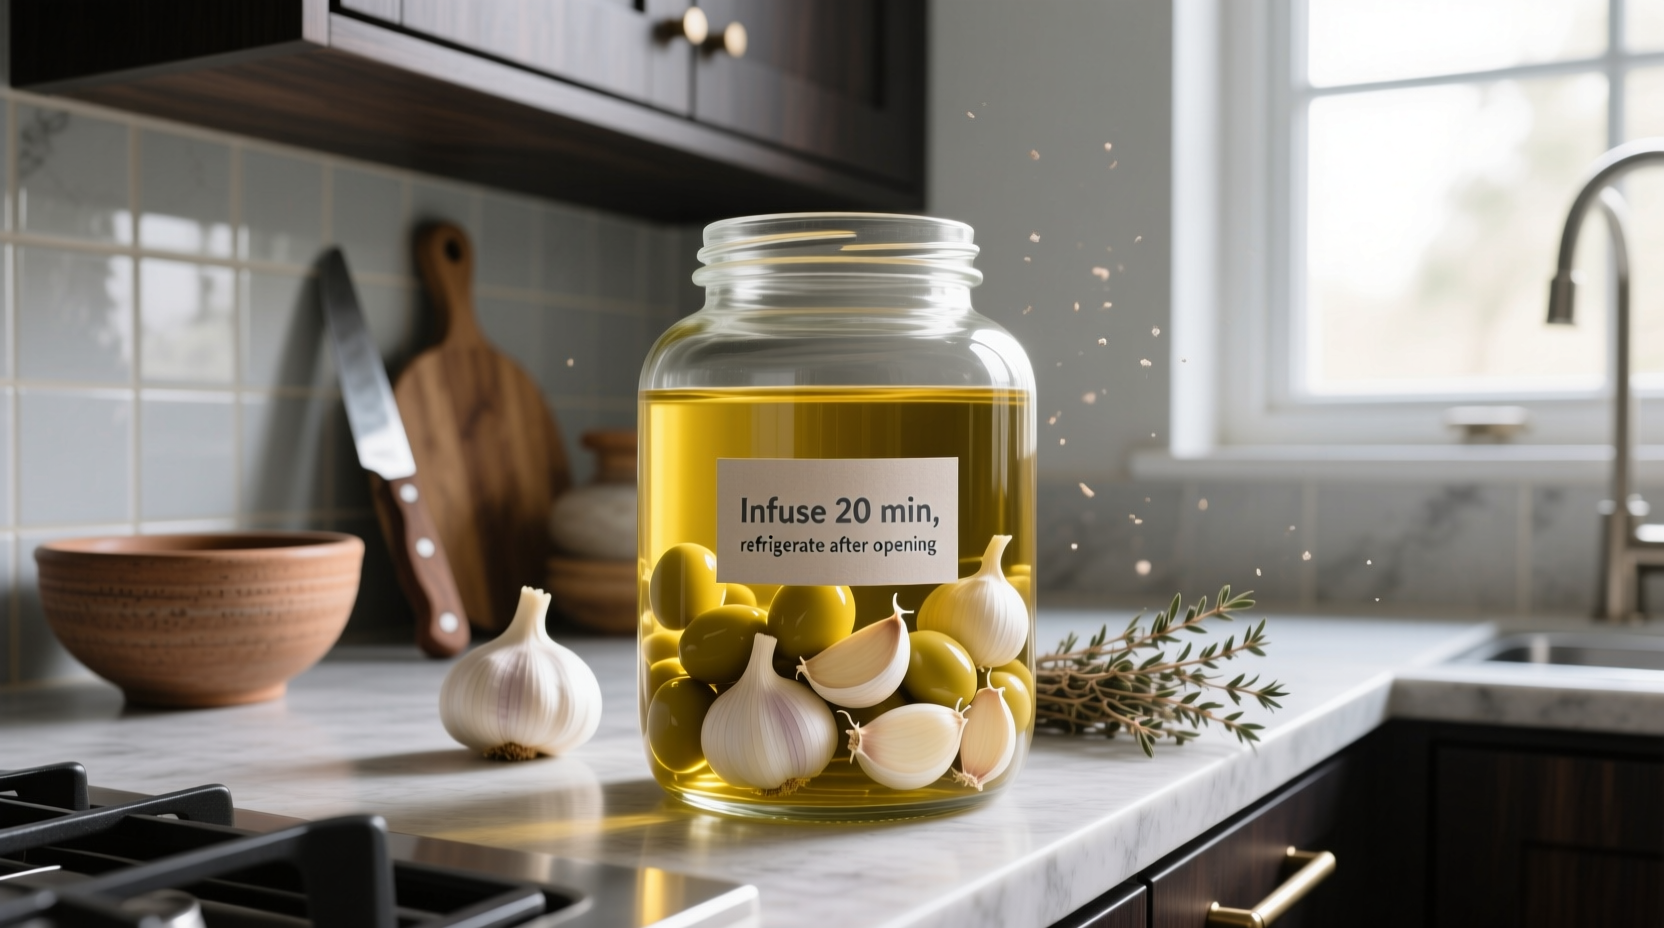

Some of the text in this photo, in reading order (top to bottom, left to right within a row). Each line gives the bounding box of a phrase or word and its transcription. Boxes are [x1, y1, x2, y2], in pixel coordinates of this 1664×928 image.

[741, 496, 940, 528] Infuse 20 min,
[740, 535, 937, 557] refrigerate after opening
